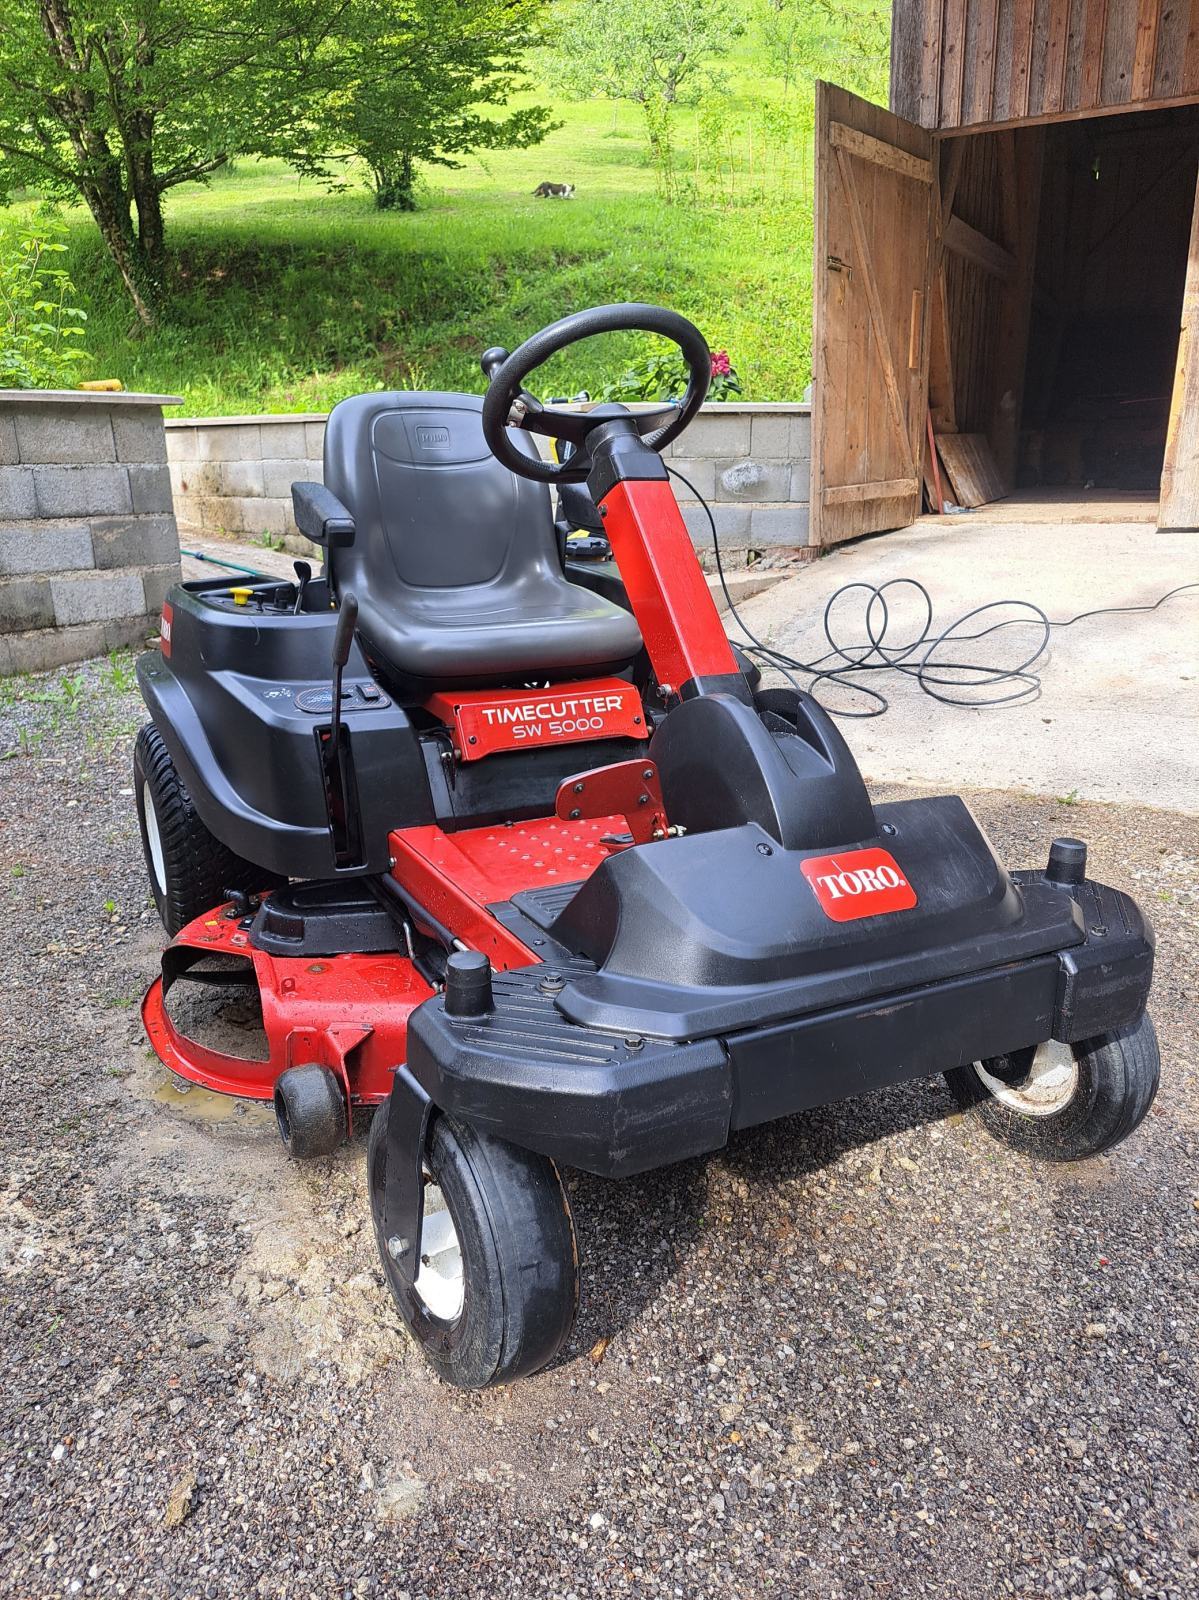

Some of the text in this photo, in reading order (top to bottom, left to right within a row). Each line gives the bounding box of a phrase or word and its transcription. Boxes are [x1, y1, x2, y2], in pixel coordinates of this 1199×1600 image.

[482, 696, 622, 725] TIMECUTTER
[512, 717, 604, 739] SW 5000
